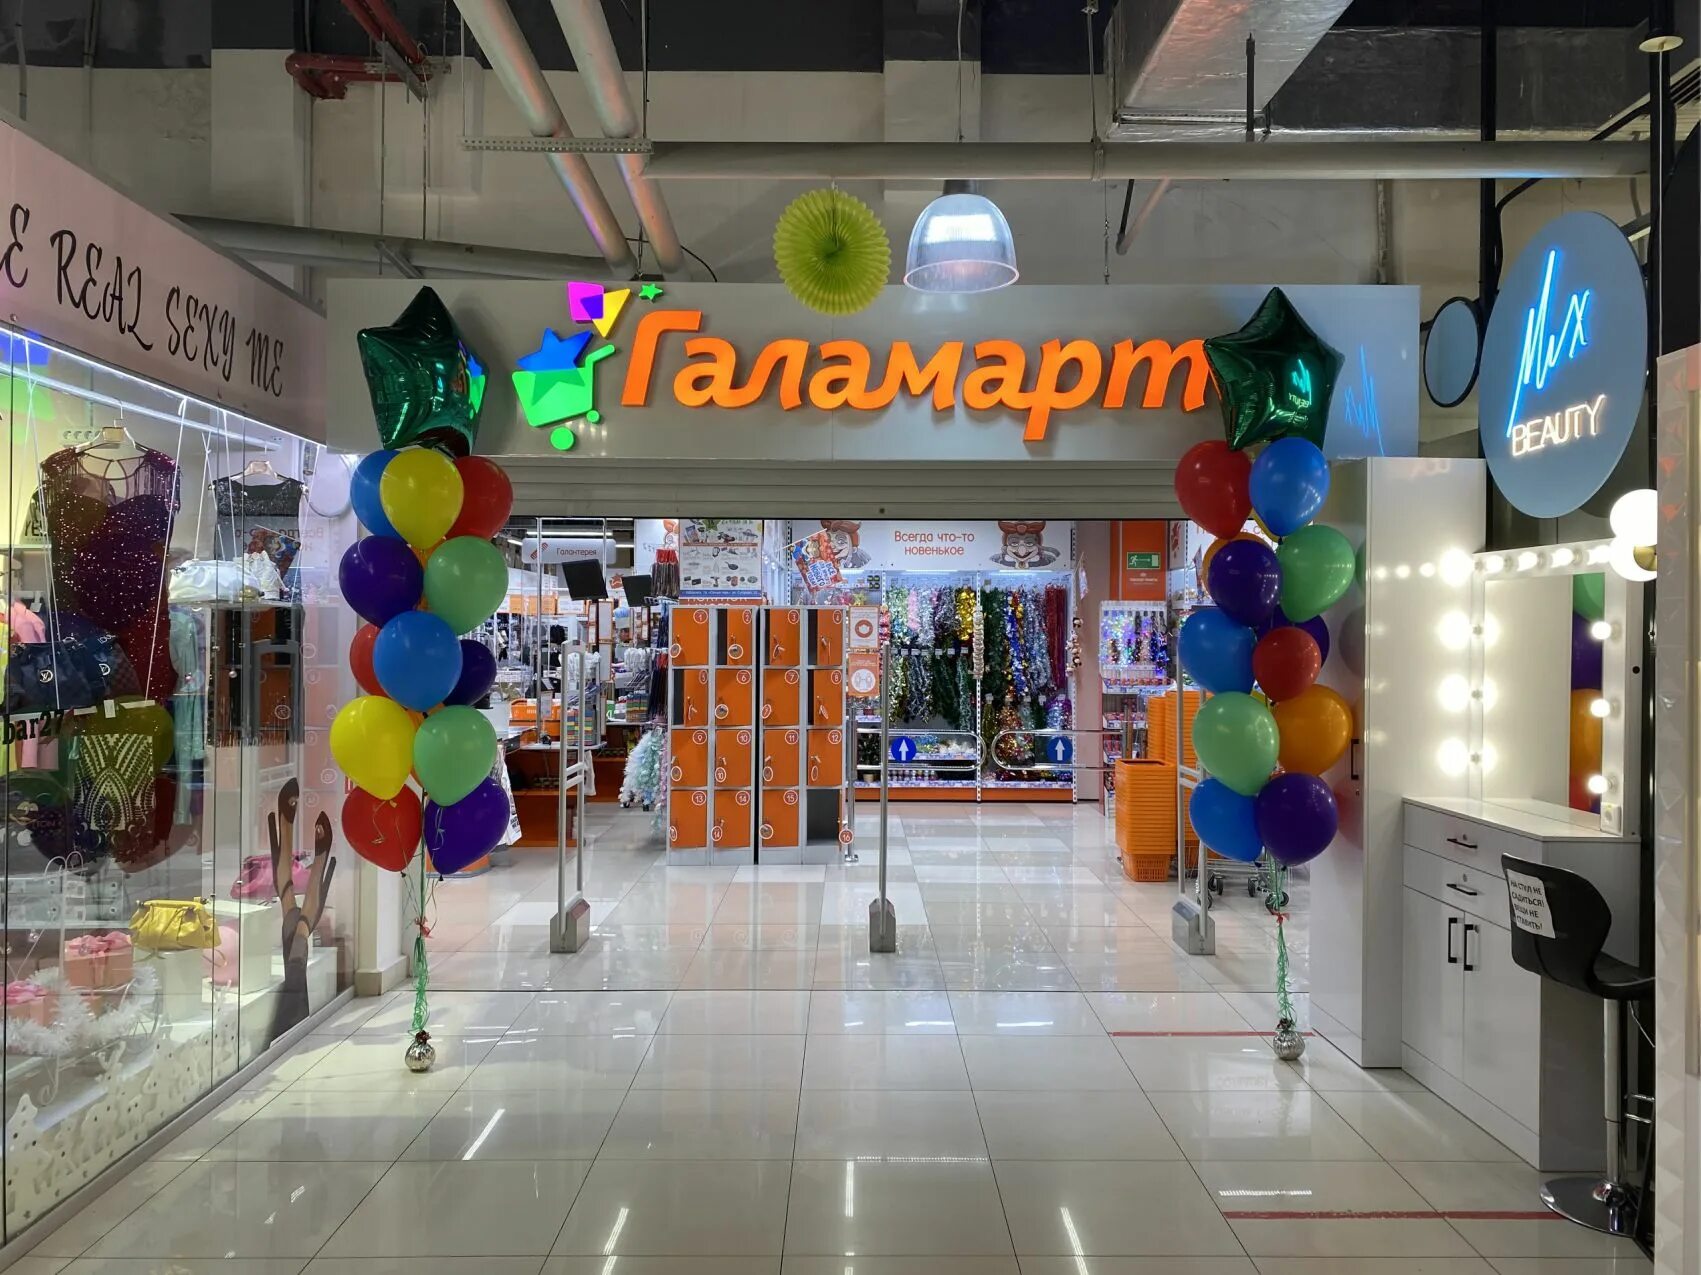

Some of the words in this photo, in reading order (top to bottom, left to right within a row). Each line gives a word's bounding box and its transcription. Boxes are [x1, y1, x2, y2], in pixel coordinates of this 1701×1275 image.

[50, 229, 153, 351] REAL
[165, 286, 236, 382] SEXY
[245, 328, 284, 397] ME
[620, 310, 1214, 441] Галамарт
[1511, 394, 1606, 457] BEAUTY
[894, 530, 934, 545] Всегда
[937, 533, 975, 543] что-то
[556, 547, 597, 556] Галантерея
[904, 546, 964, 556] новенькое
[740, 734, 748, 742] 10
[788, 734, 795, 742] 11
[831, 734, 838, 742] 12
[695, 794, 703, 802] 13
[739, 794, 747, 802] 14
[787, 794, 794, 802] 15
[843, 833, 850, 842] 16
[1511, 880, 1517, 888] НА
[1518, 883, 1532, 894] СТУЛ
[1533, 887, 1542, 896] НЕ
[1512, 892, 1545, 908] САДИТЬСЯ!
[1530, 910, 1539, 918] НЕ
[1517, 916, 1543, 930] СТАВИТЬ!
